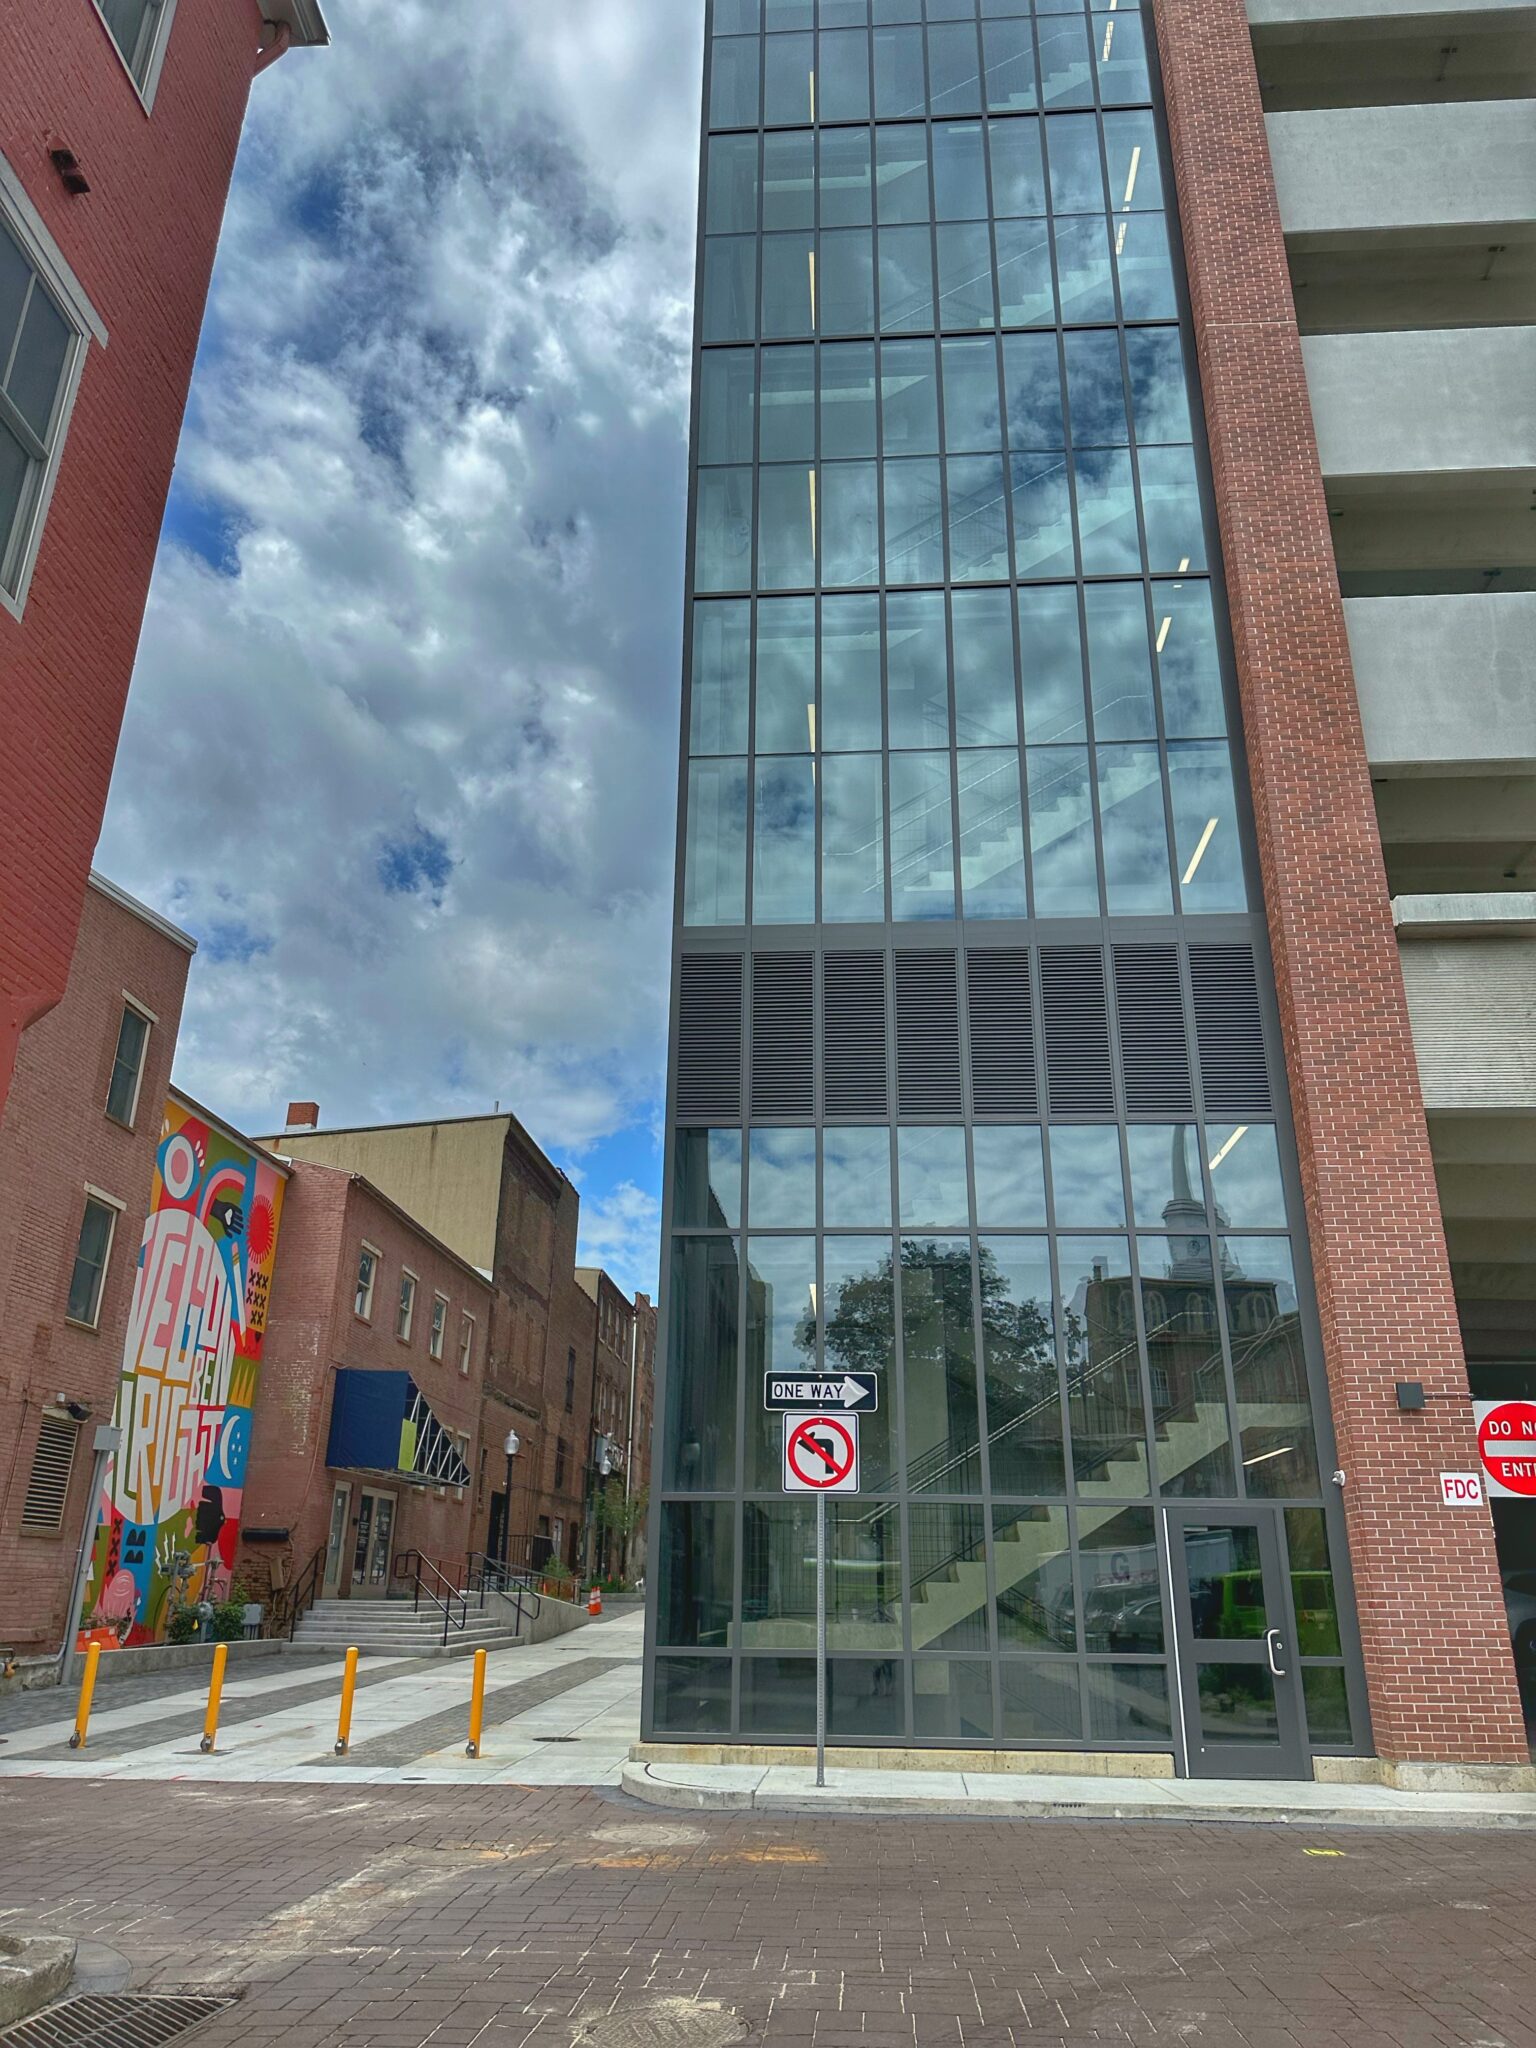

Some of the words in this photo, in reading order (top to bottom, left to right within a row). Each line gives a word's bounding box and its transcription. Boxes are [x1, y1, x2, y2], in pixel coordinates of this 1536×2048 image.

[774, 1383, 803, 1398] ONE
[811, 1384, 844, 1399] WAY
[1488, 1420, 1512, 1436] DO
[1443, 1478, 1479, 1500] FDC
